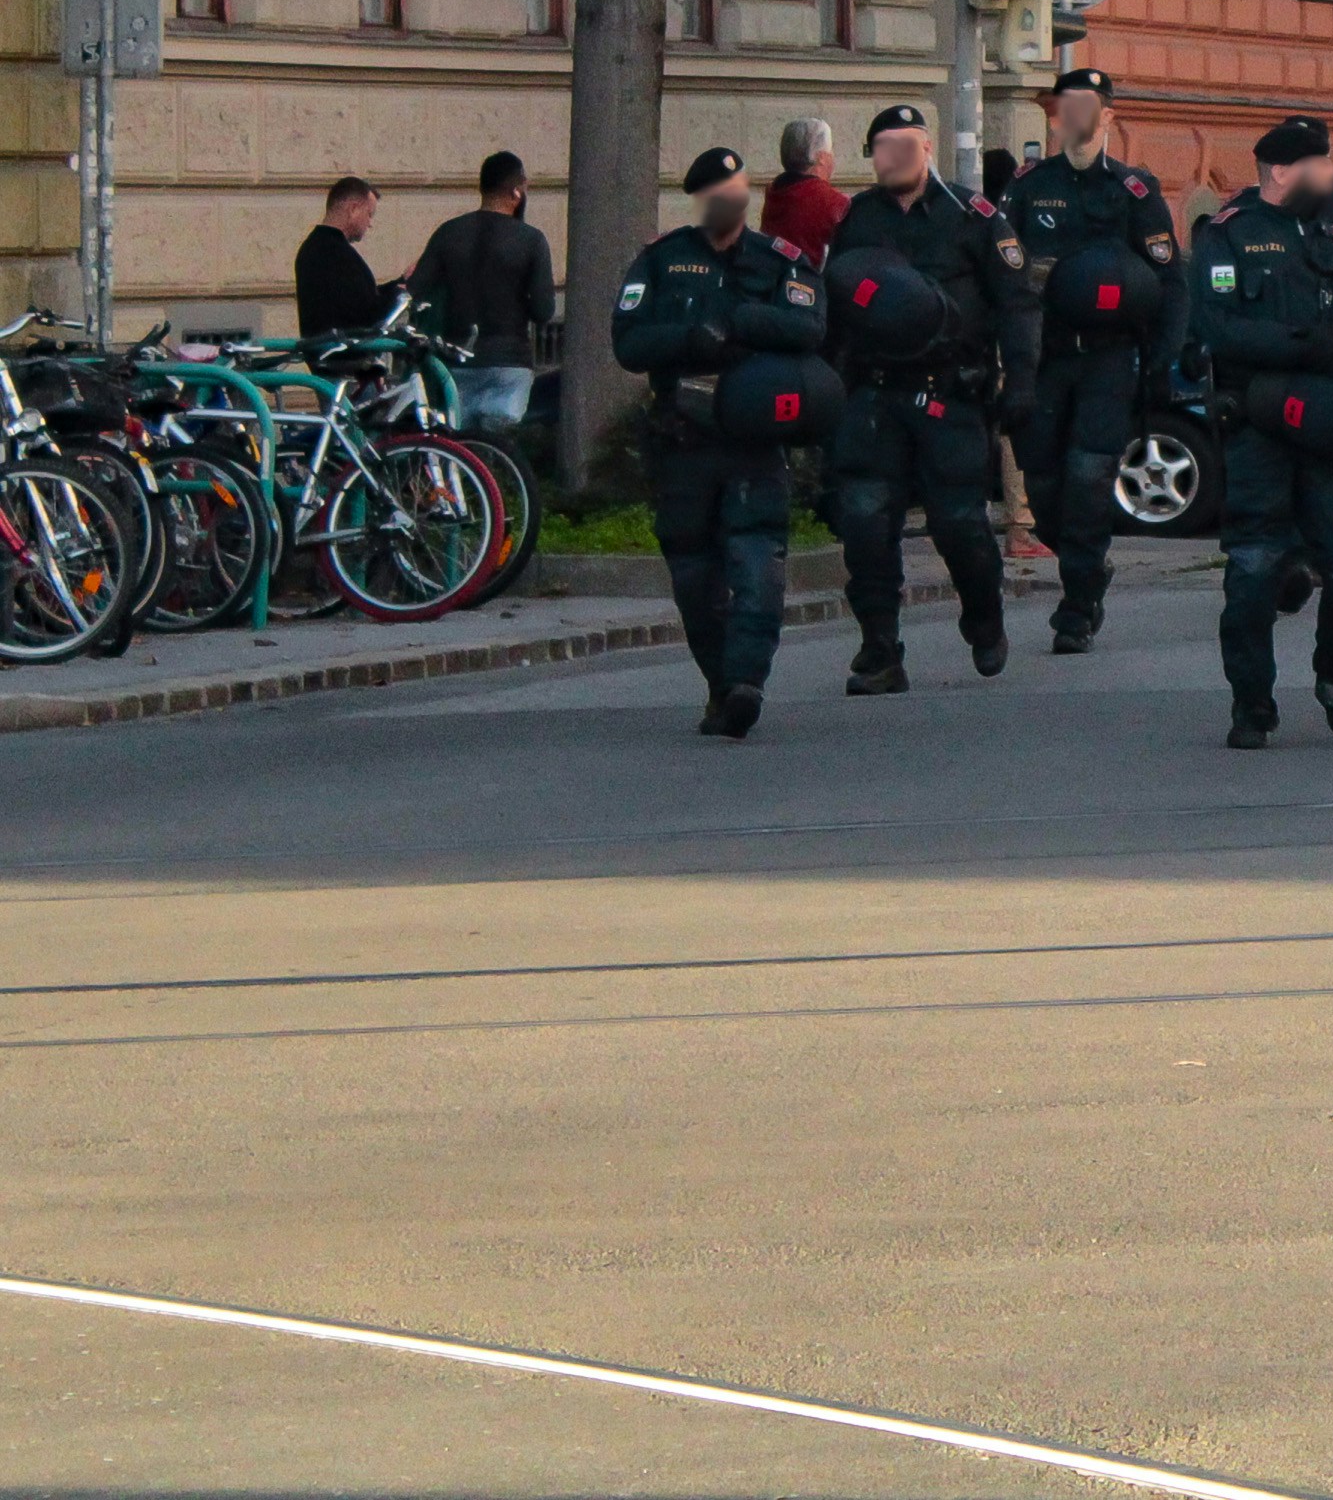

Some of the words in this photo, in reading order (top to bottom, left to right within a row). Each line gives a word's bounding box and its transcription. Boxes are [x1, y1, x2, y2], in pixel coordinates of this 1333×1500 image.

[1244, 242, 1286, 253] POLIZEI
[668, 264, 710, 274] POLIZEI
[1214, 271, 1233, 283] EE
